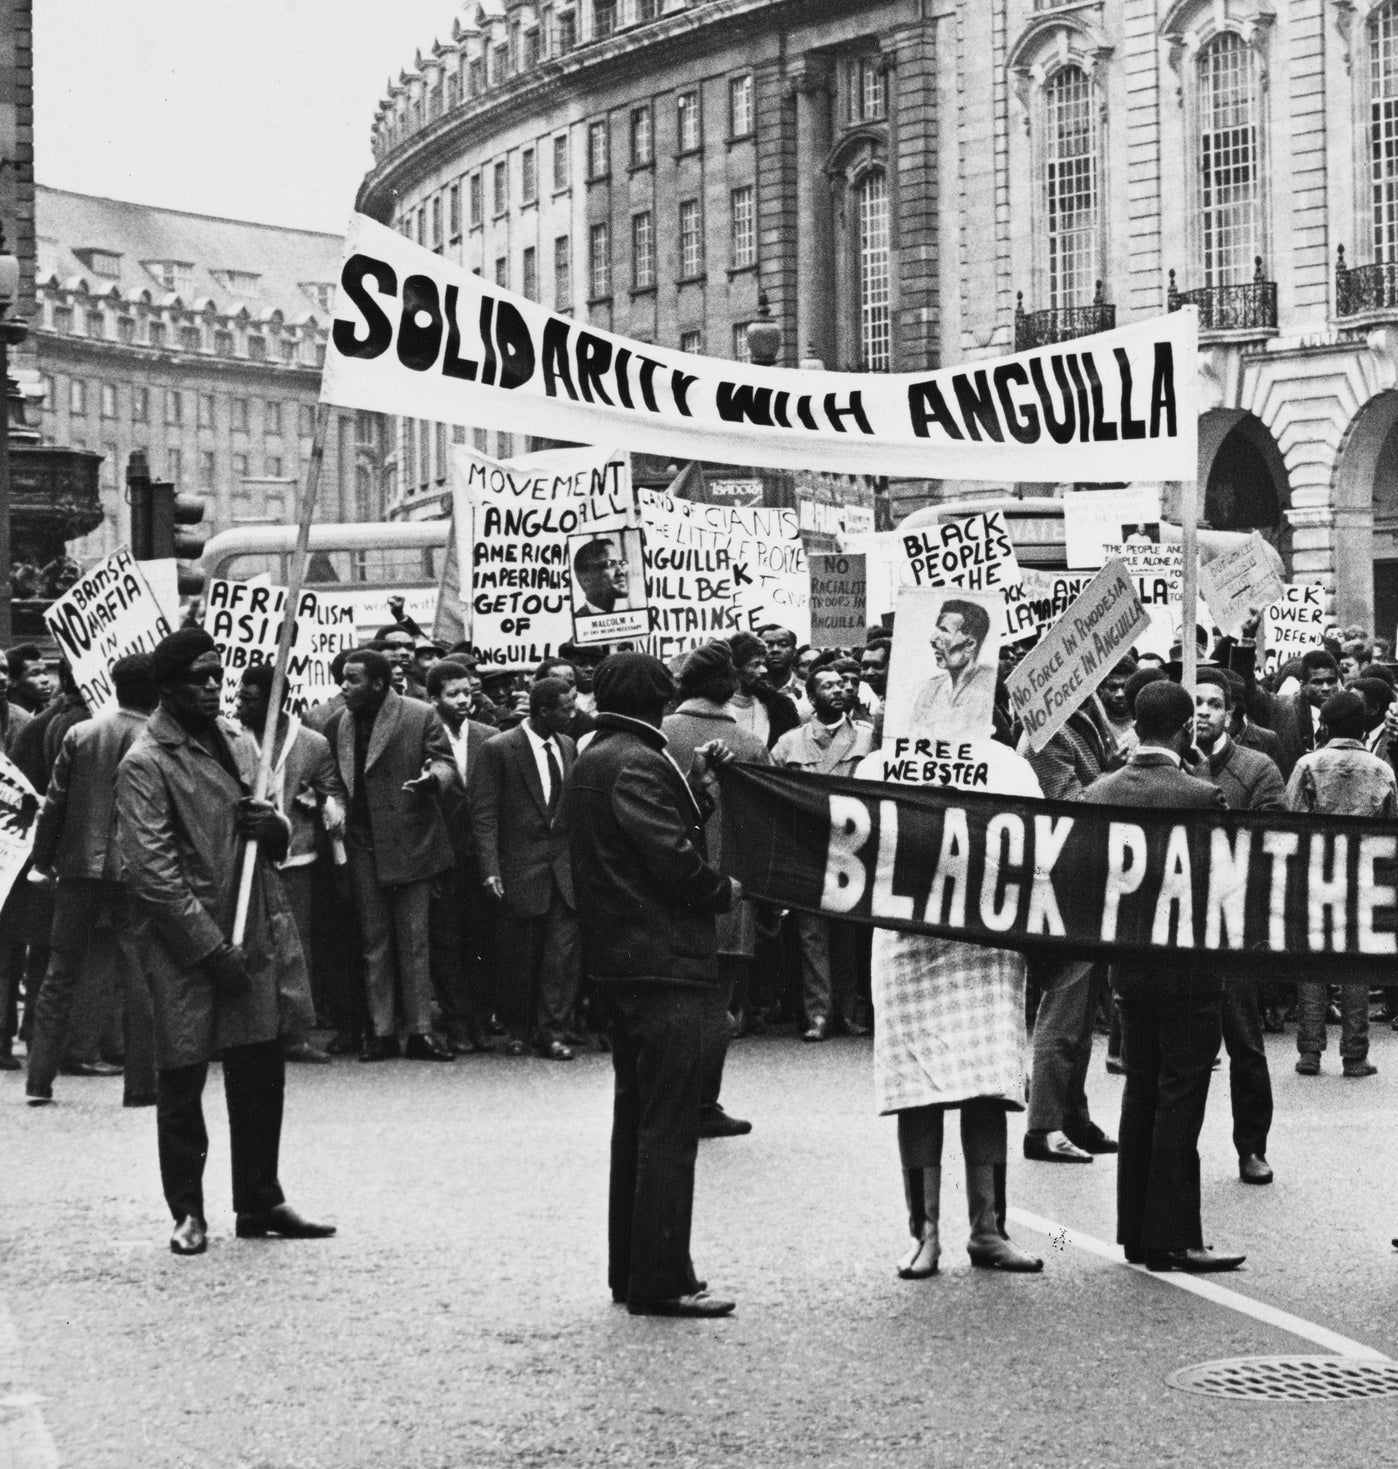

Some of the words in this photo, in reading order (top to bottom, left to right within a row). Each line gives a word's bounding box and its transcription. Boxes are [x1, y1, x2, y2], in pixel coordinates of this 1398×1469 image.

[332, 253, 700, 417] SOLIDARITY
[715, 380, 874, 434] WITH
[908, 341, 1178, 445] ANGUILLA
[468, 461, 625, 501] MOVEMENT
[579, 493, 627, 522] ALL
[484, 506, 577, 537] ANGLO
[903, 512, 1005, 558] BLACK
[643, 547, 730, 572] NGUILLA
[911, 535, 1012, 586] PEOPLES
[1126, 545, 1160, 555] PEOPLE
[1143, 556, 1171, 566] ALONE
[474, 567, 570, 589] IMPERIALIS
[824, 555, 849, 574] NO
[951, 562, 1001, 591] THE
[72, 551, 132, 610] BRITISH
[695, 577, 731, 602] BE
[87, 574, 141, 638] MAFIA
[647, 606, 736, 633] RITAINS
[1270, 605, 1323, 624] OWER
[48, 602, 92, 659] NO
[500, 618, 530, 636] OF
[591, 616, 626, 629] MALCOLM
[101, 633, 118, 658] IN
[473, 643, 555, 665] ANGUILL
[1012, 687, 1031, 710] NO
[1028, 651, 1064, 693] FORCE
[1061, 634, 1078, 656] IN
[1073, 576, 1127, 641] RHODESIA
[1024, 707, 1047, 737] NO
[1043, 667, 1083, 716] FORCE
[1081, 650, 1098, 676] IN
[1092, 597, 1145, 663] ANGUILLA
[895, 738, 974, 761] FREE
[883, 760, 989, 786] WEBSTER
[820, 793, 1075, 937] BLACK
